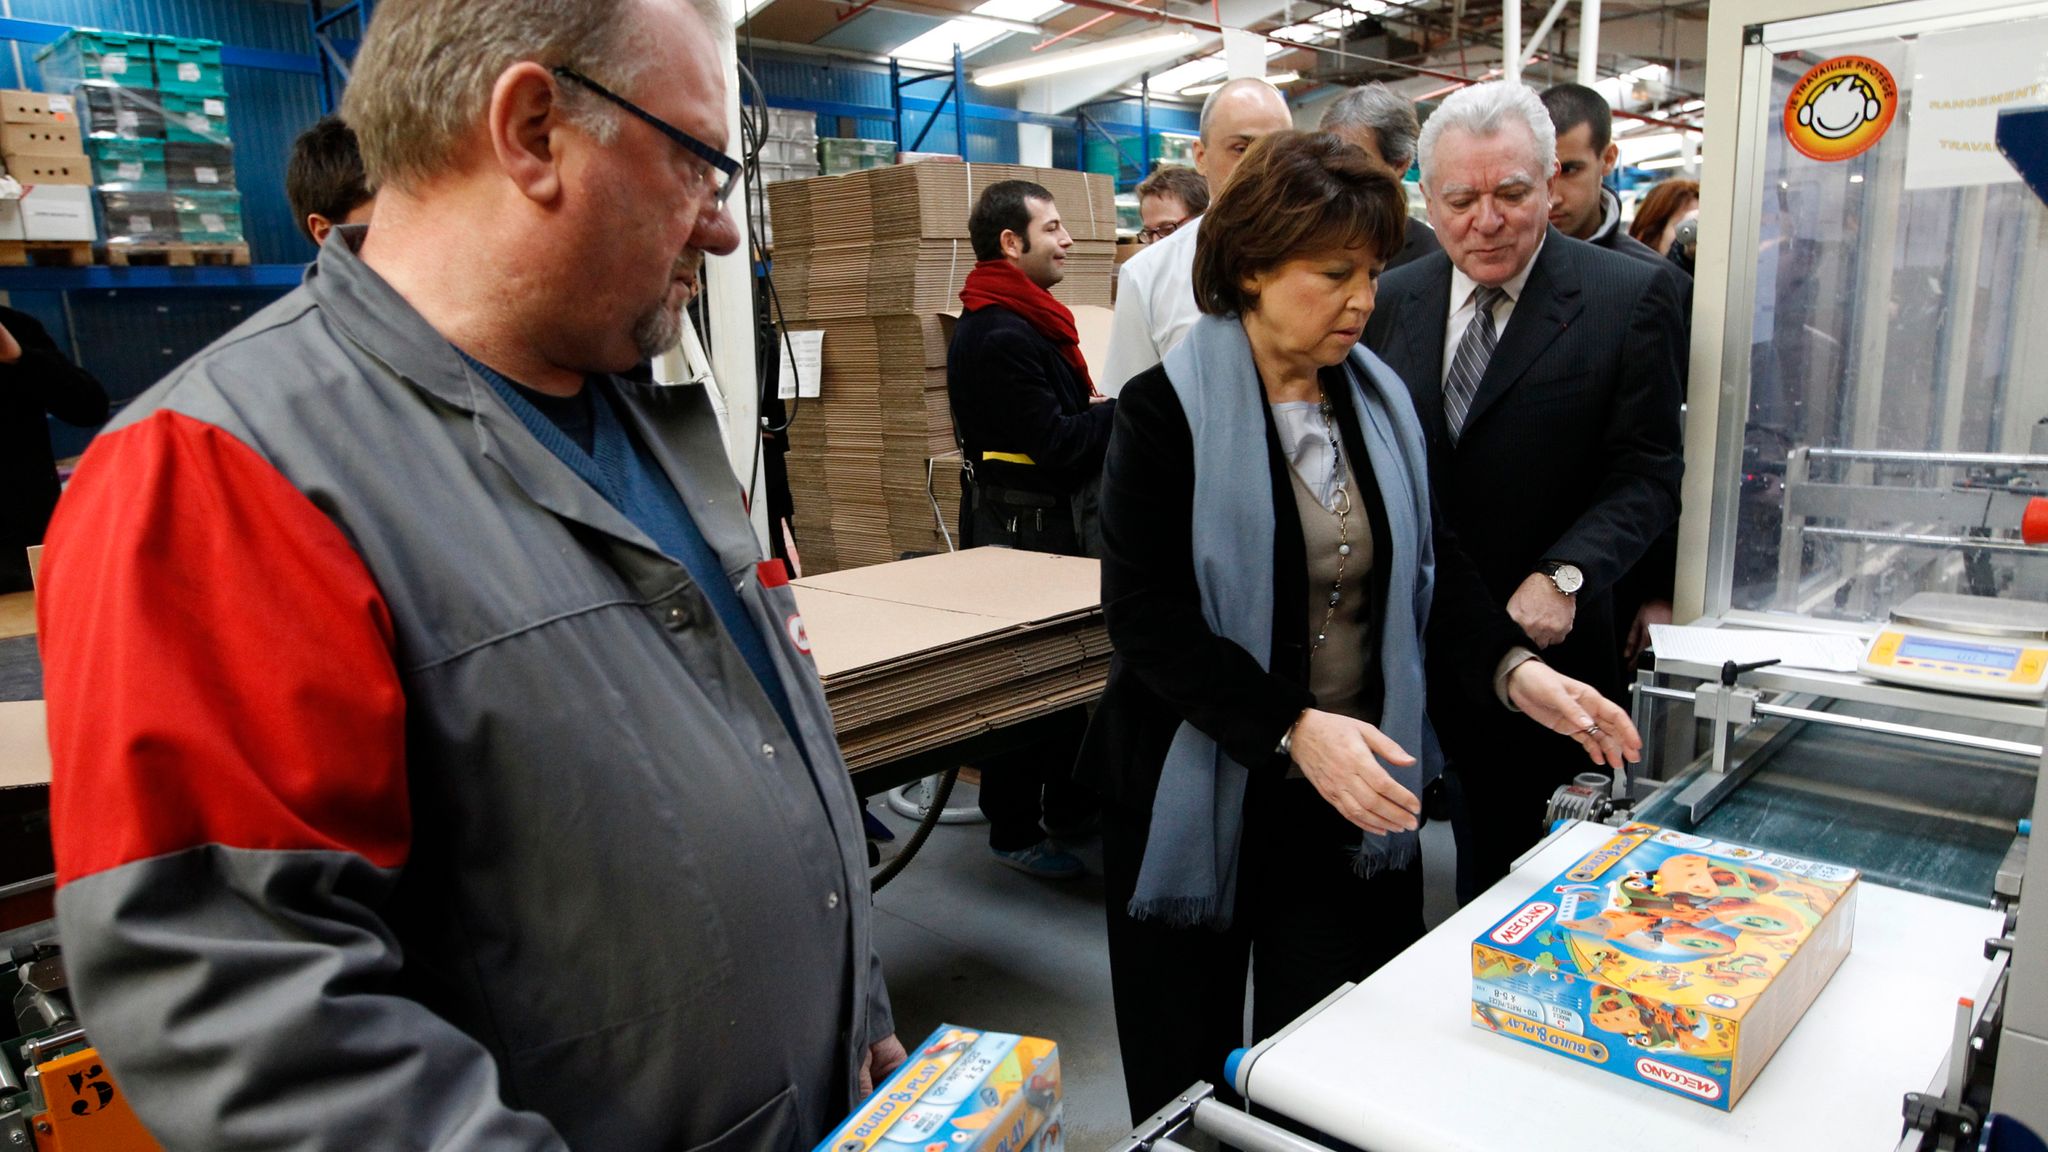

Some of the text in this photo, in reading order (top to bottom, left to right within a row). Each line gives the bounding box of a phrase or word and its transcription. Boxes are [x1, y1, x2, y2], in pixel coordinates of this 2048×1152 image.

[1796, 60, 1854, 96] TRAVAILLE
[1501, 904, 1549, 942] MECCANO
[1505, 1017, 1587, 1054] BUILD & PLAY
[67, 1064, 114, 1116] 5
[1641, 1062, 1716, 1093] MECCANO
[854, 1101, 896, 1138] BUILD
[907, 1063, 939, 1091] PLAY
